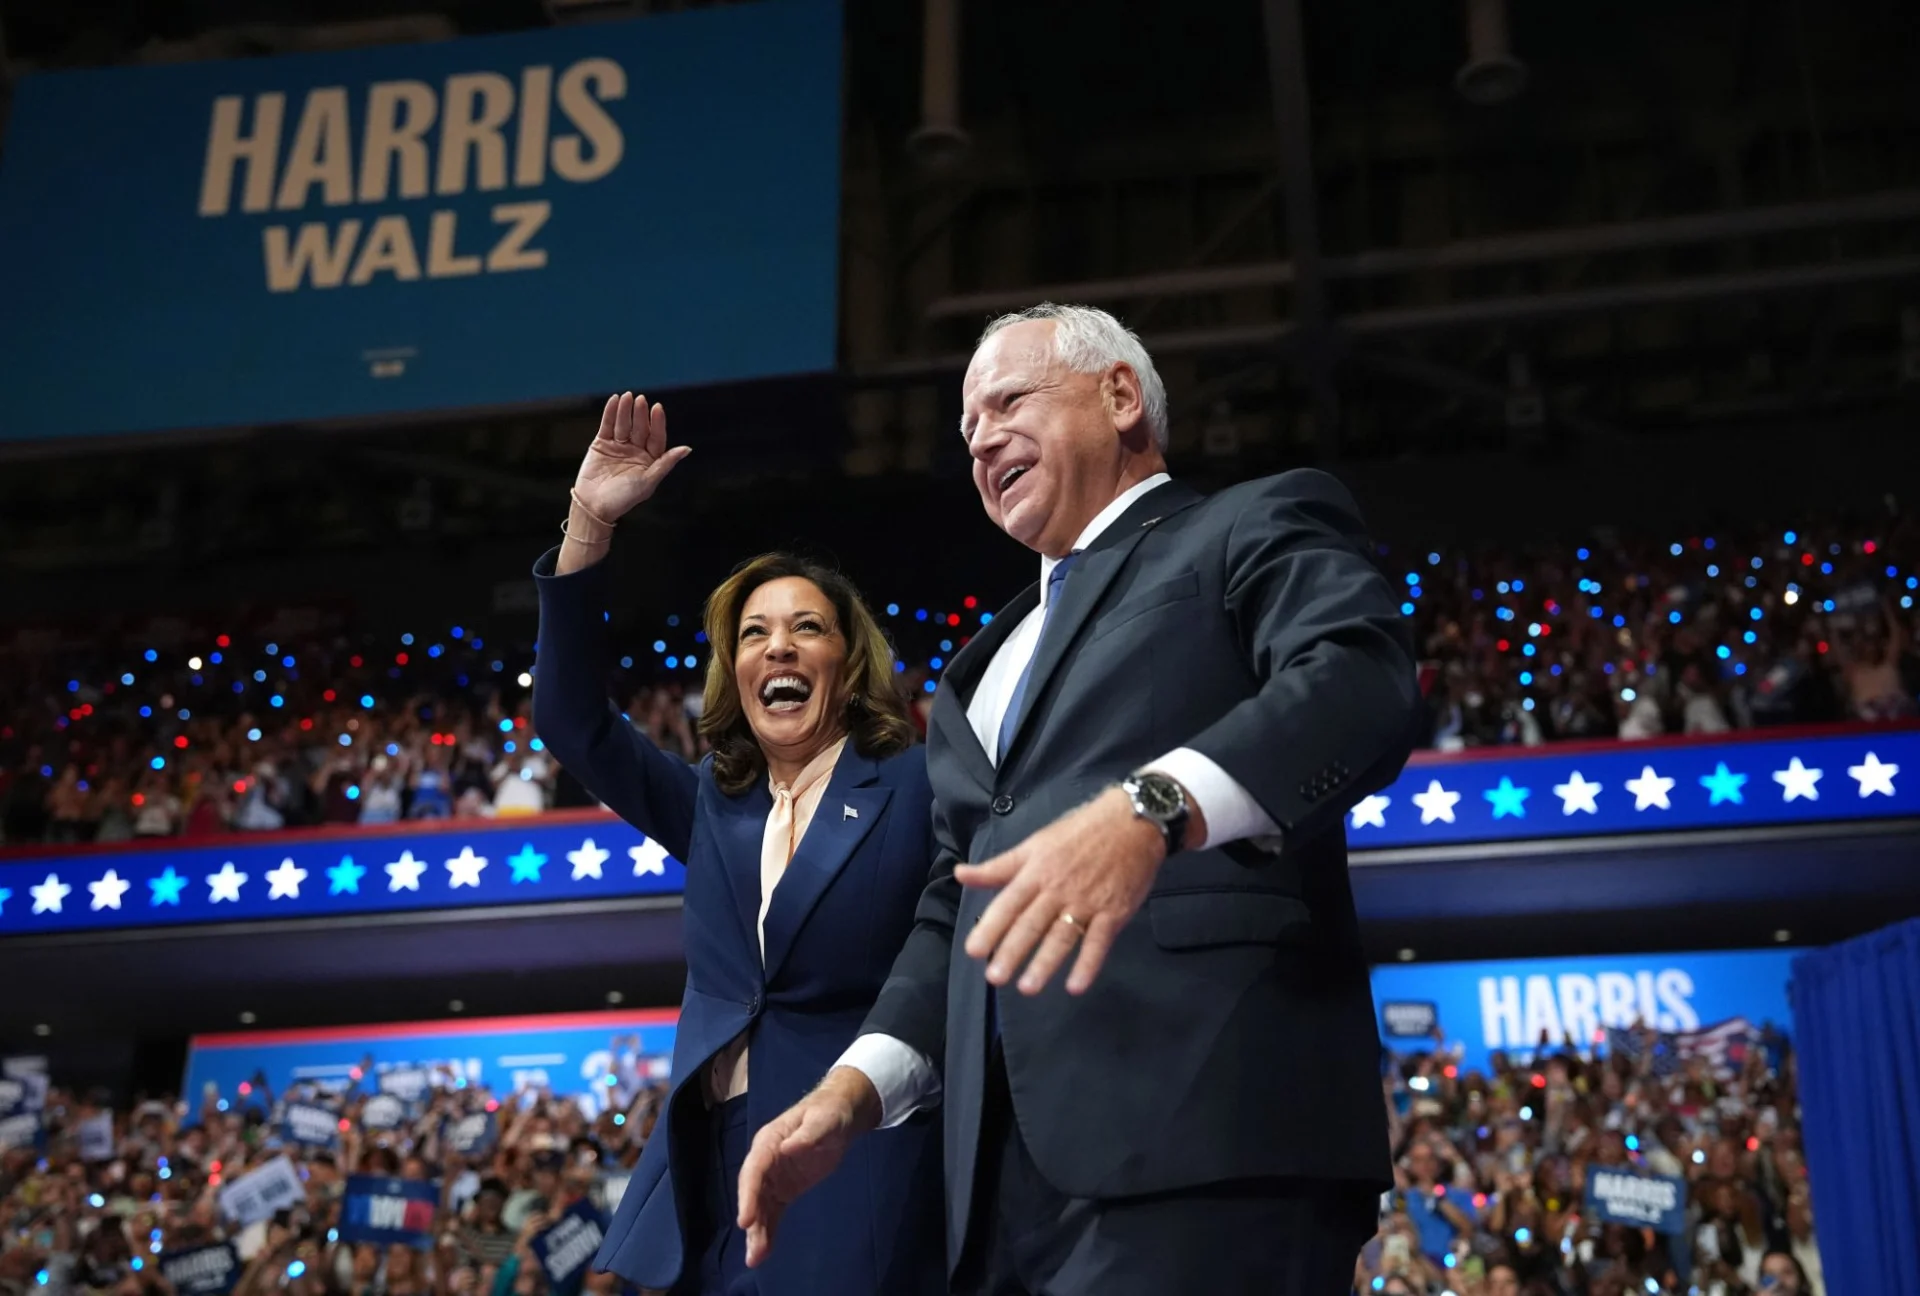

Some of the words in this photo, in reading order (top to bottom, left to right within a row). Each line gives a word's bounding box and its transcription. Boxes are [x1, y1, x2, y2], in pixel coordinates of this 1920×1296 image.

[198, 57, 628, 216] HARRIS
[263, 201, 551, 292] WALZ
[1479, 968, 1699, 1048] HARRIS
